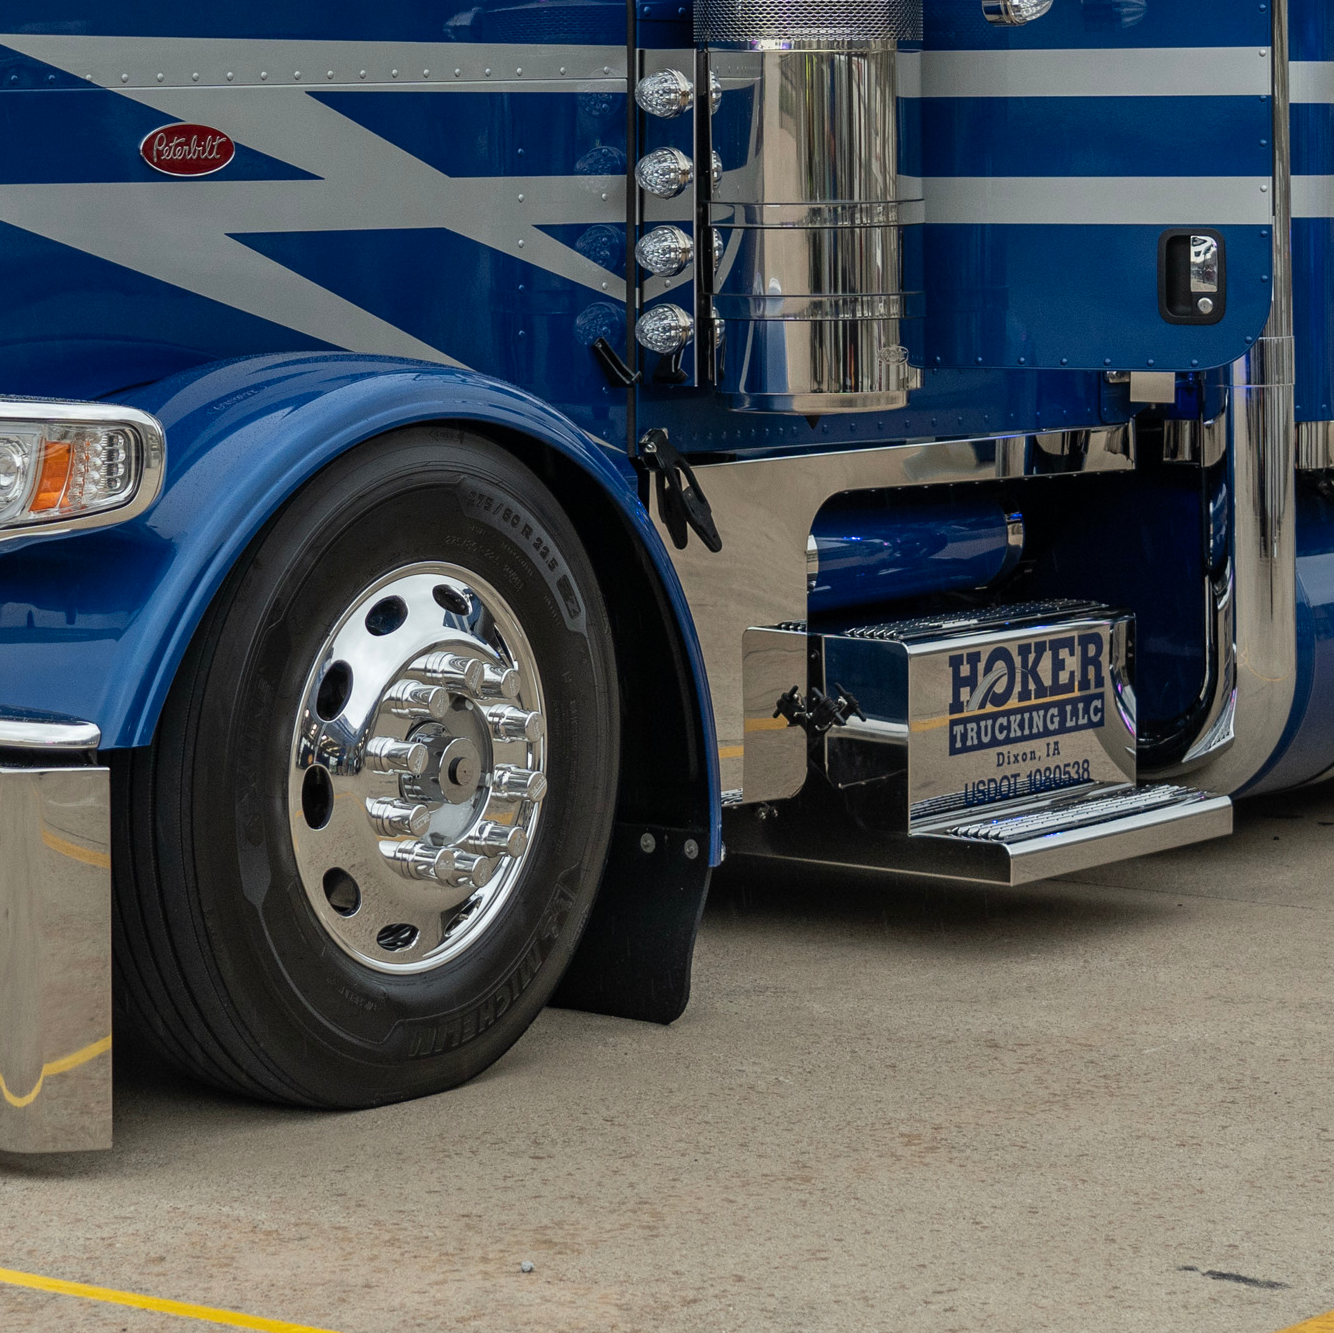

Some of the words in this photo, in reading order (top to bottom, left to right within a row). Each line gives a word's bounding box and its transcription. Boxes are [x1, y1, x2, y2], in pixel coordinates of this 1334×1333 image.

[152, 132, 227, 163] Peterbilt
[948, 631, 1105, 716] HOKER
[953, 707, 1060, 748] TRUCKING
[1065, 699, 1103, 727] LLC
[996, 748, 1042, 767] Dixon,
[1046, 741, 1061, 757] IA
[964, 772, 1021, 805] USDOT
[1027, 759, 1090, 794] 1080538
[408, 936, 545, 1058] MICHELIN
